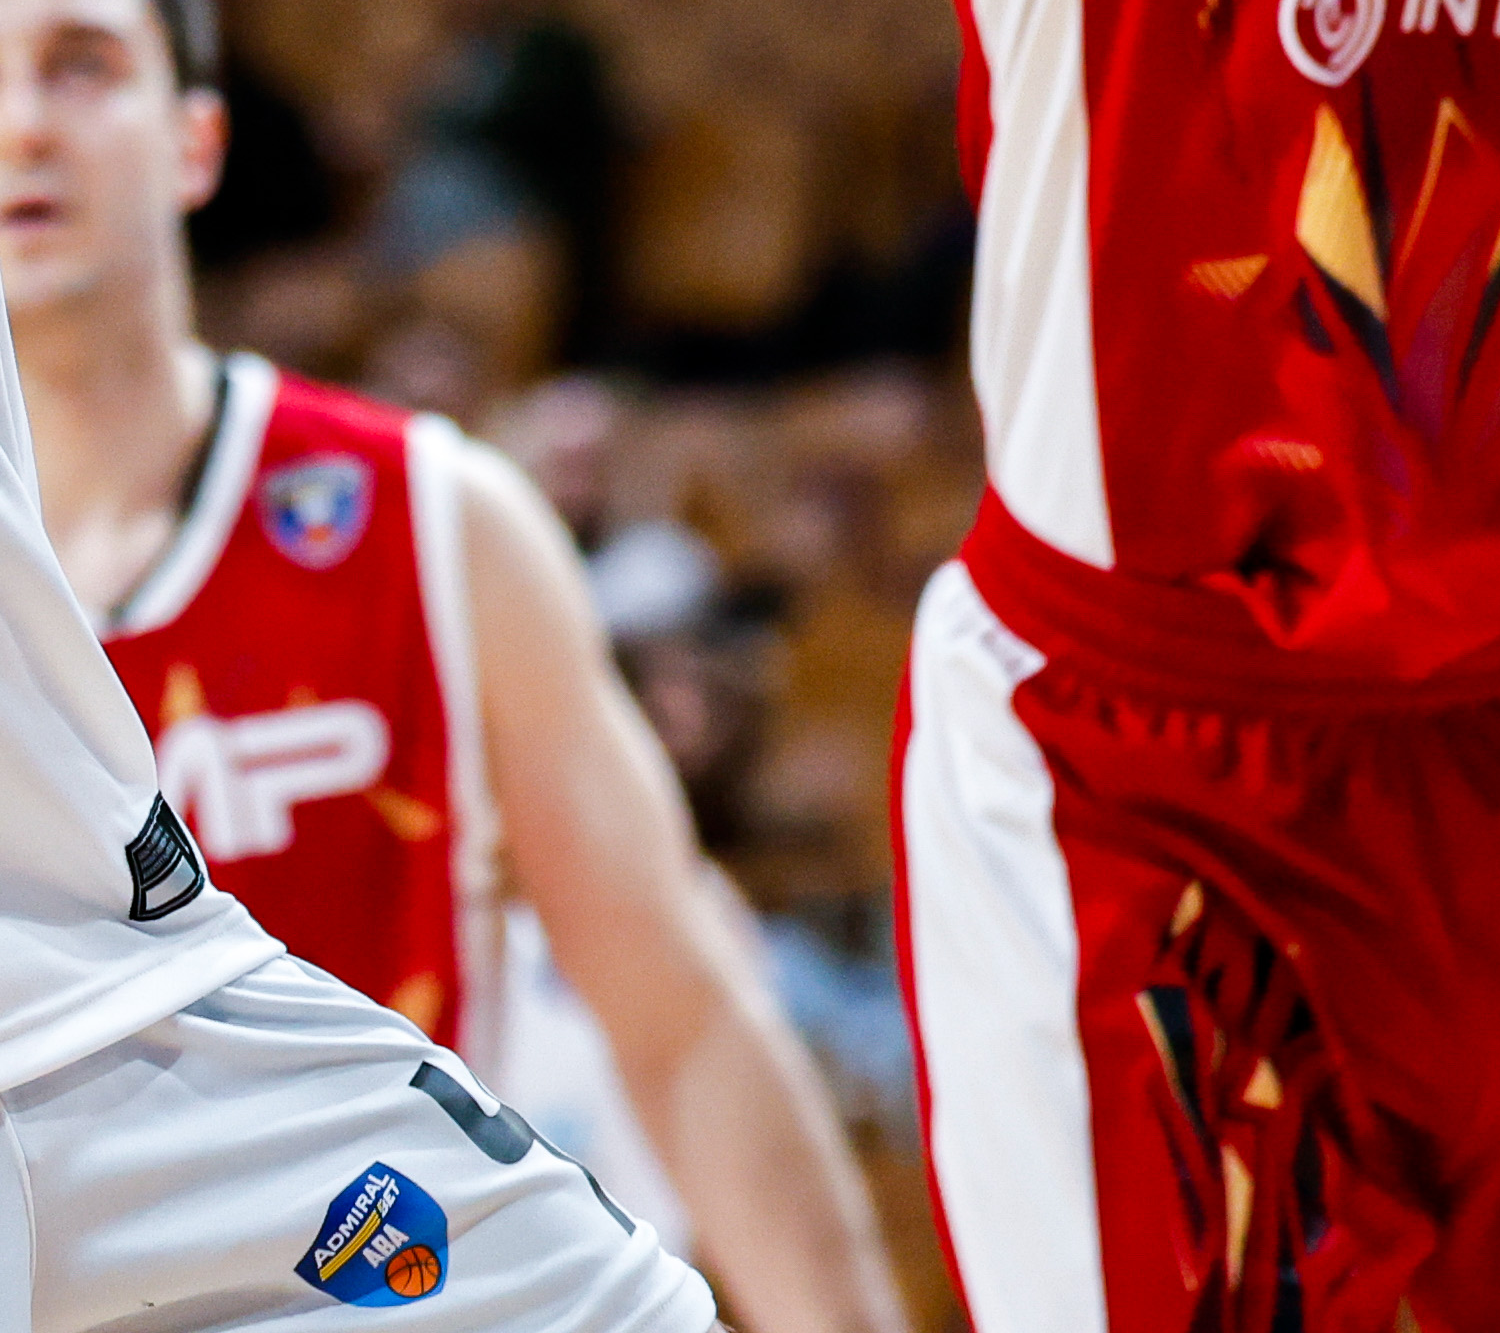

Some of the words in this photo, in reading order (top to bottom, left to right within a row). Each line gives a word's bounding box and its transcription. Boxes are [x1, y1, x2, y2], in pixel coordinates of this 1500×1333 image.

[376, 1178, 400, 1218] BET
[314, 1174, 390, 1269] ADMIRAL
[362, 1223, 410, 1269] ABA
